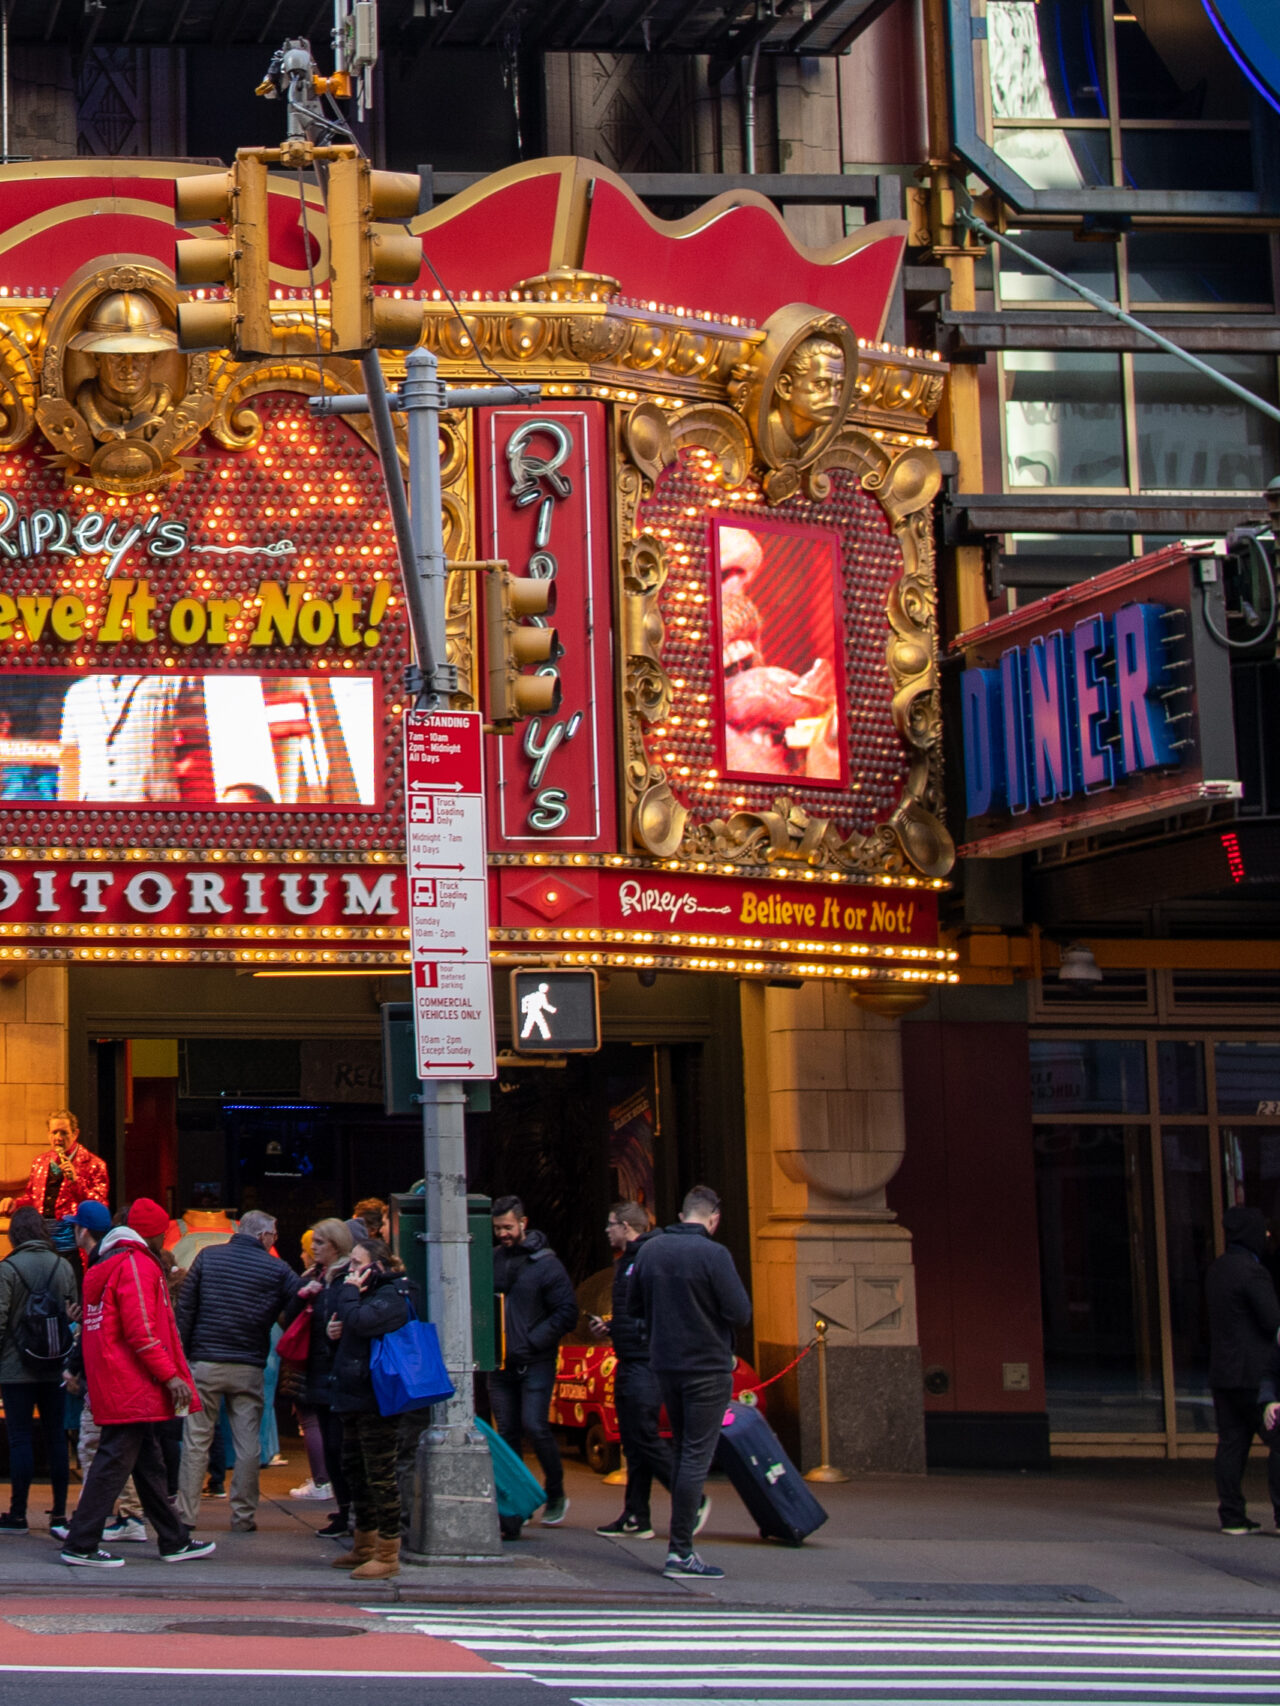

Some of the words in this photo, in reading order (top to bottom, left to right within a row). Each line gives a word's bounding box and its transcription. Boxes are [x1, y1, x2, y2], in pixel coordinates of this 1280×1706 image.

[96, 577, 155, 644] It
[168, 604, 241, 646] or
[250, 579, 392, 648] Not!
[960, 603, 1174, 818] DINER
[424, 716, 470, 729] STANDING
[409, 732, 424, 741] 7am
[429, 733, 449, 743] 10am
[409, 742, 425, 753] 2pm
[430, 743, 461, 755] Midnight
[409, 753, 419, 761] All
[421, 754, 440, 764] Days
[436, 798, 456, 806] Truck
[436, 807, 465, 817] Loading
[436, 817, 453, 826] Only
[412, 833, 441, 844] Midnight
[448, 834, 463, 842] 7am
[412, 845, 420, 853] All
[422, 845, 440, 855] Days
[440, 881, 459, 889] Truck
[440, 890, 467, 900] Loading
[440, 900, 455, 910] Only
[620, 880, 698, 922] Ripley's
[739, 891, 816, 928] Believe
[821, 897, 841, 929] It
[844, 908, 867, 931] or
[869, 901, 914, 934] Not!
[415, 916, 440, 927] Sunday
[415, 929, 434, 937] 10am
[440, 929, 456, 939] 2pm
[422, 963, 431, 987] 1
[440, 965, 453, 973] hour
[440, 973, 466, 981] metered
[440, 982, 463, 990] parking
[419, 997, 472, 1008] COMMERCIAL
[420, 1010, 460, 1020] VEHICLES
[461, 1010, 481, 1020] ONLY
[421, 1035, 440, 1044] 10am
[446, 1036, 461, 1046] 2pm
[422, 1046, 445, 1056] Except
[447, 1046, 472, 1056] Sunday
